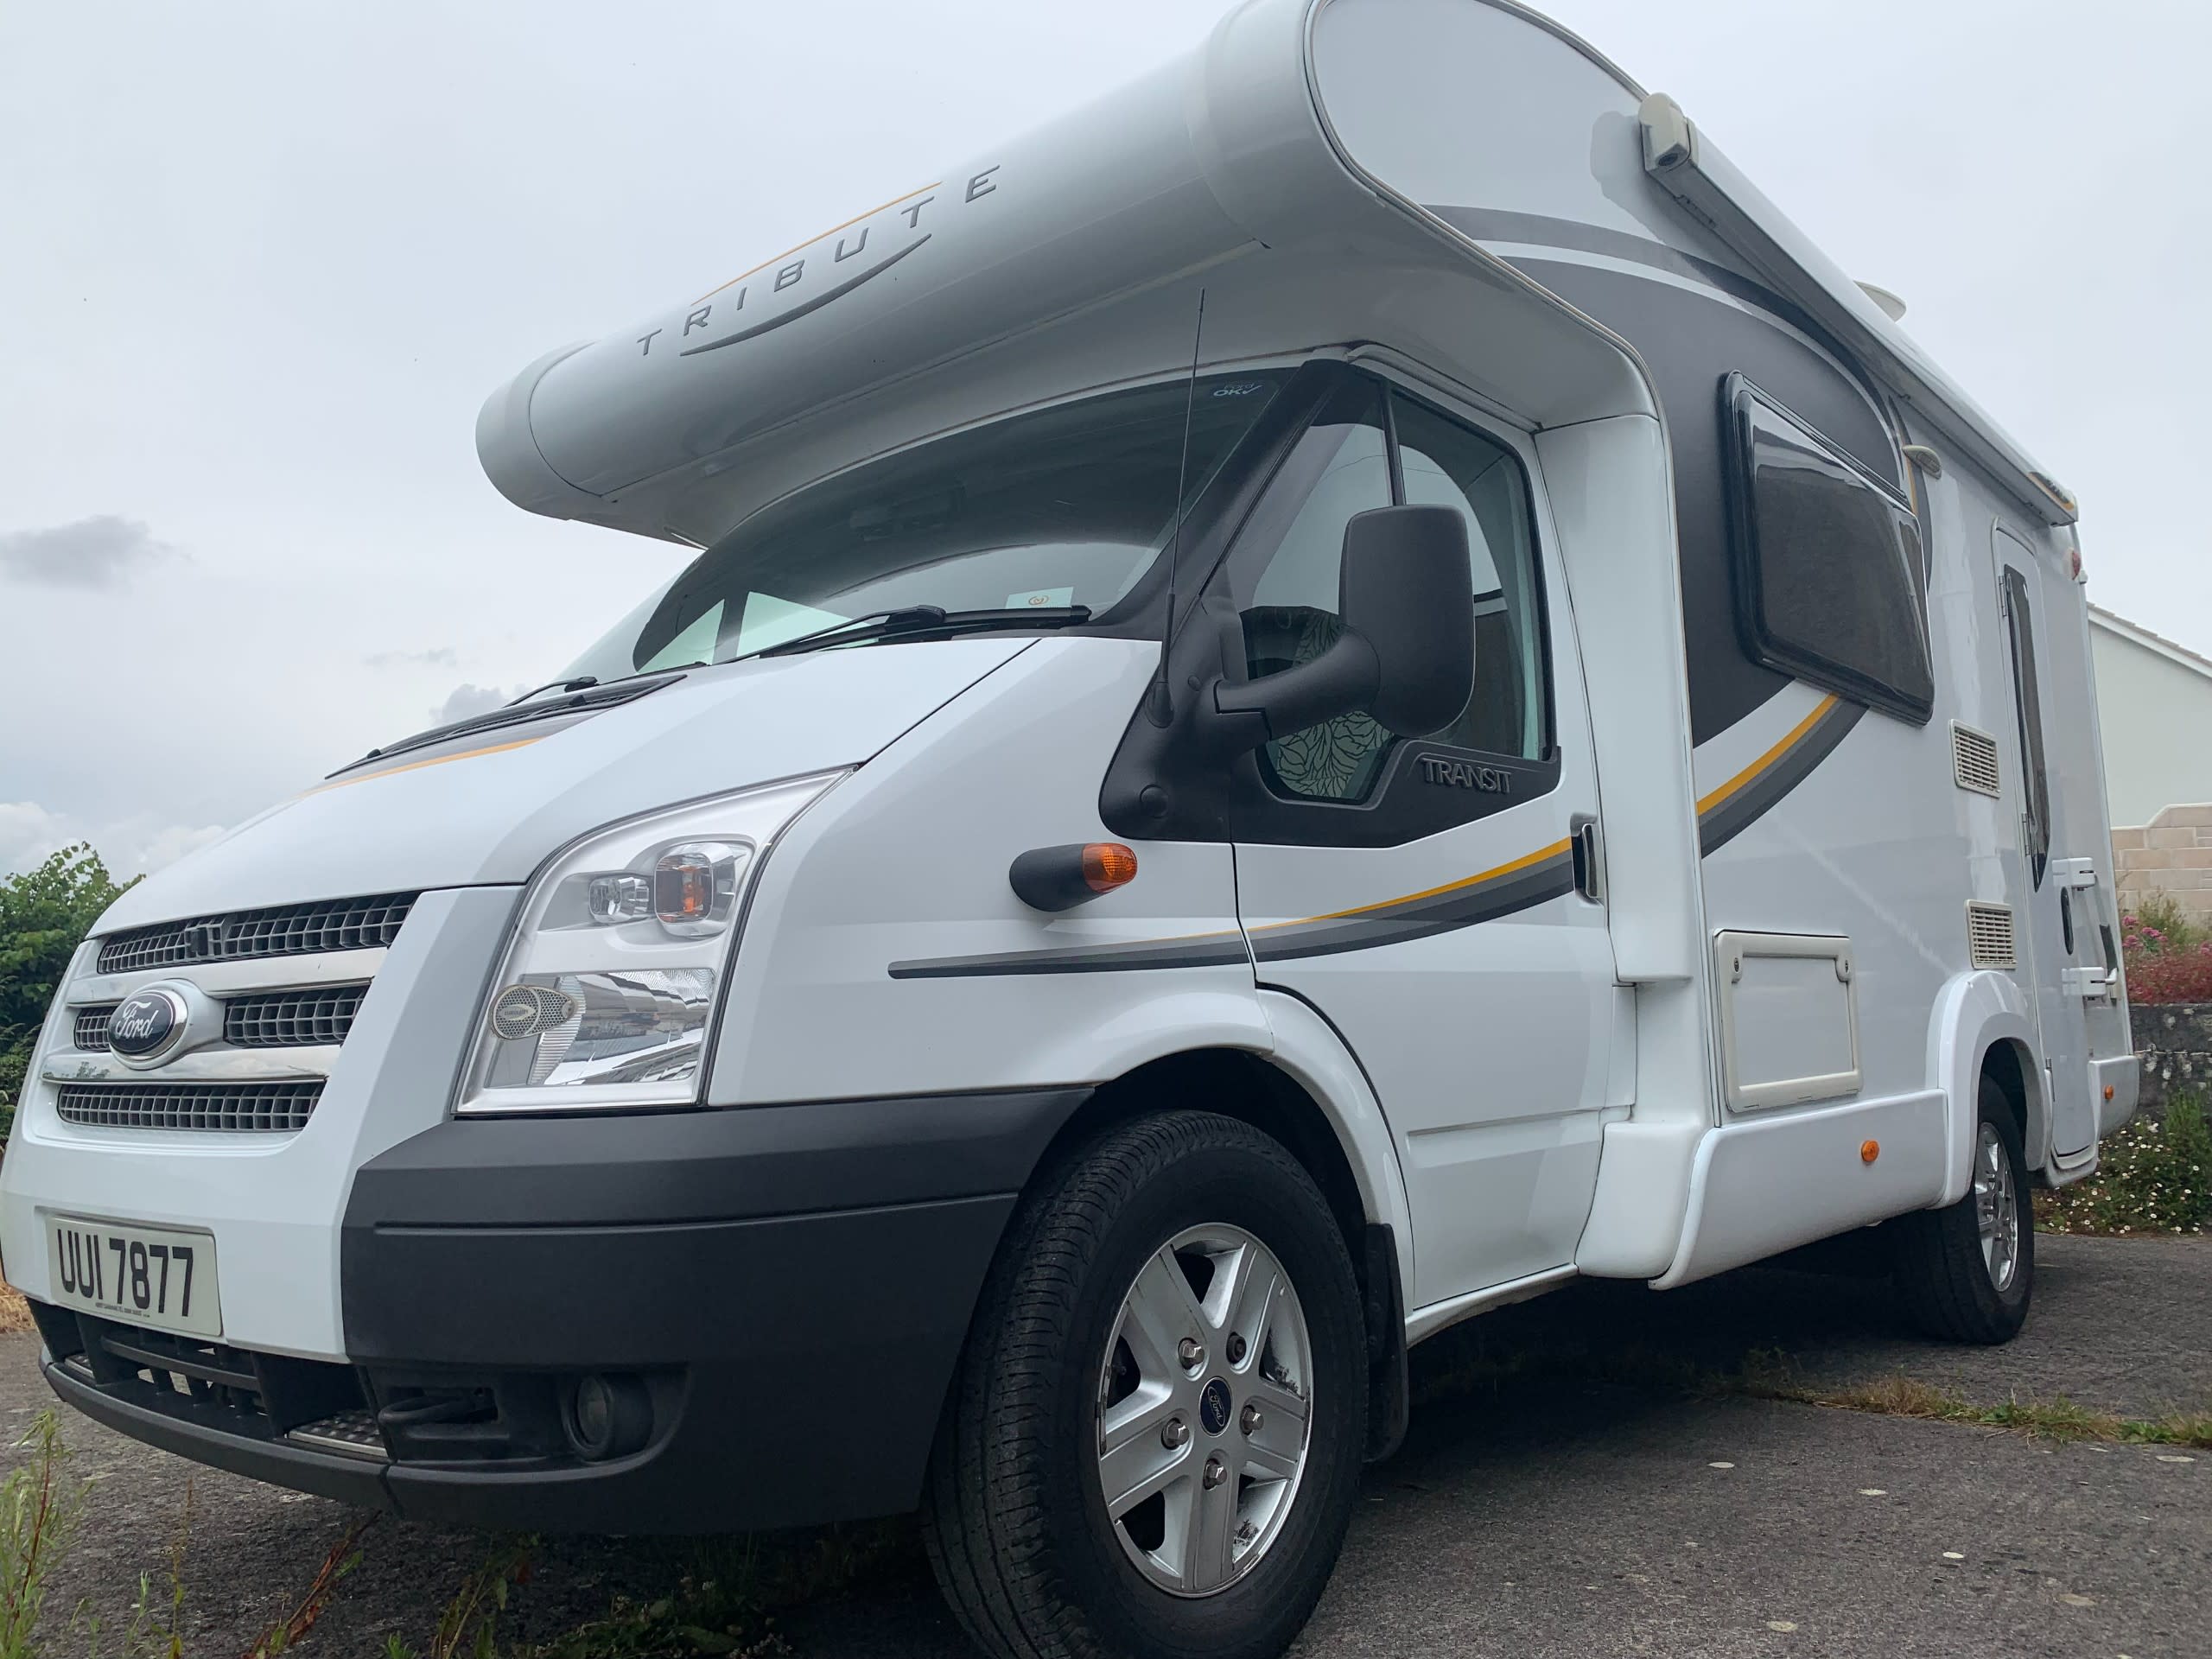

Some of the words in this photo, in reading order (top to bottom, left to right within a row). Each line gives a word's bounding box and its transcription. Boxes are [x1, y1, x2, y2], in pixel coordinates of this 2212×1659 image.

[636, 164, 1001, 356] TRIBUTE
[1421, 757, 1512, 794] TRANSIT
[114, 1001, 159, 1039] Ford
[57, 1229, 103, 1300] UUI
[109, 1236, 194, 1317] 7877
[1210, 1395, 1224, 1420] Ford
